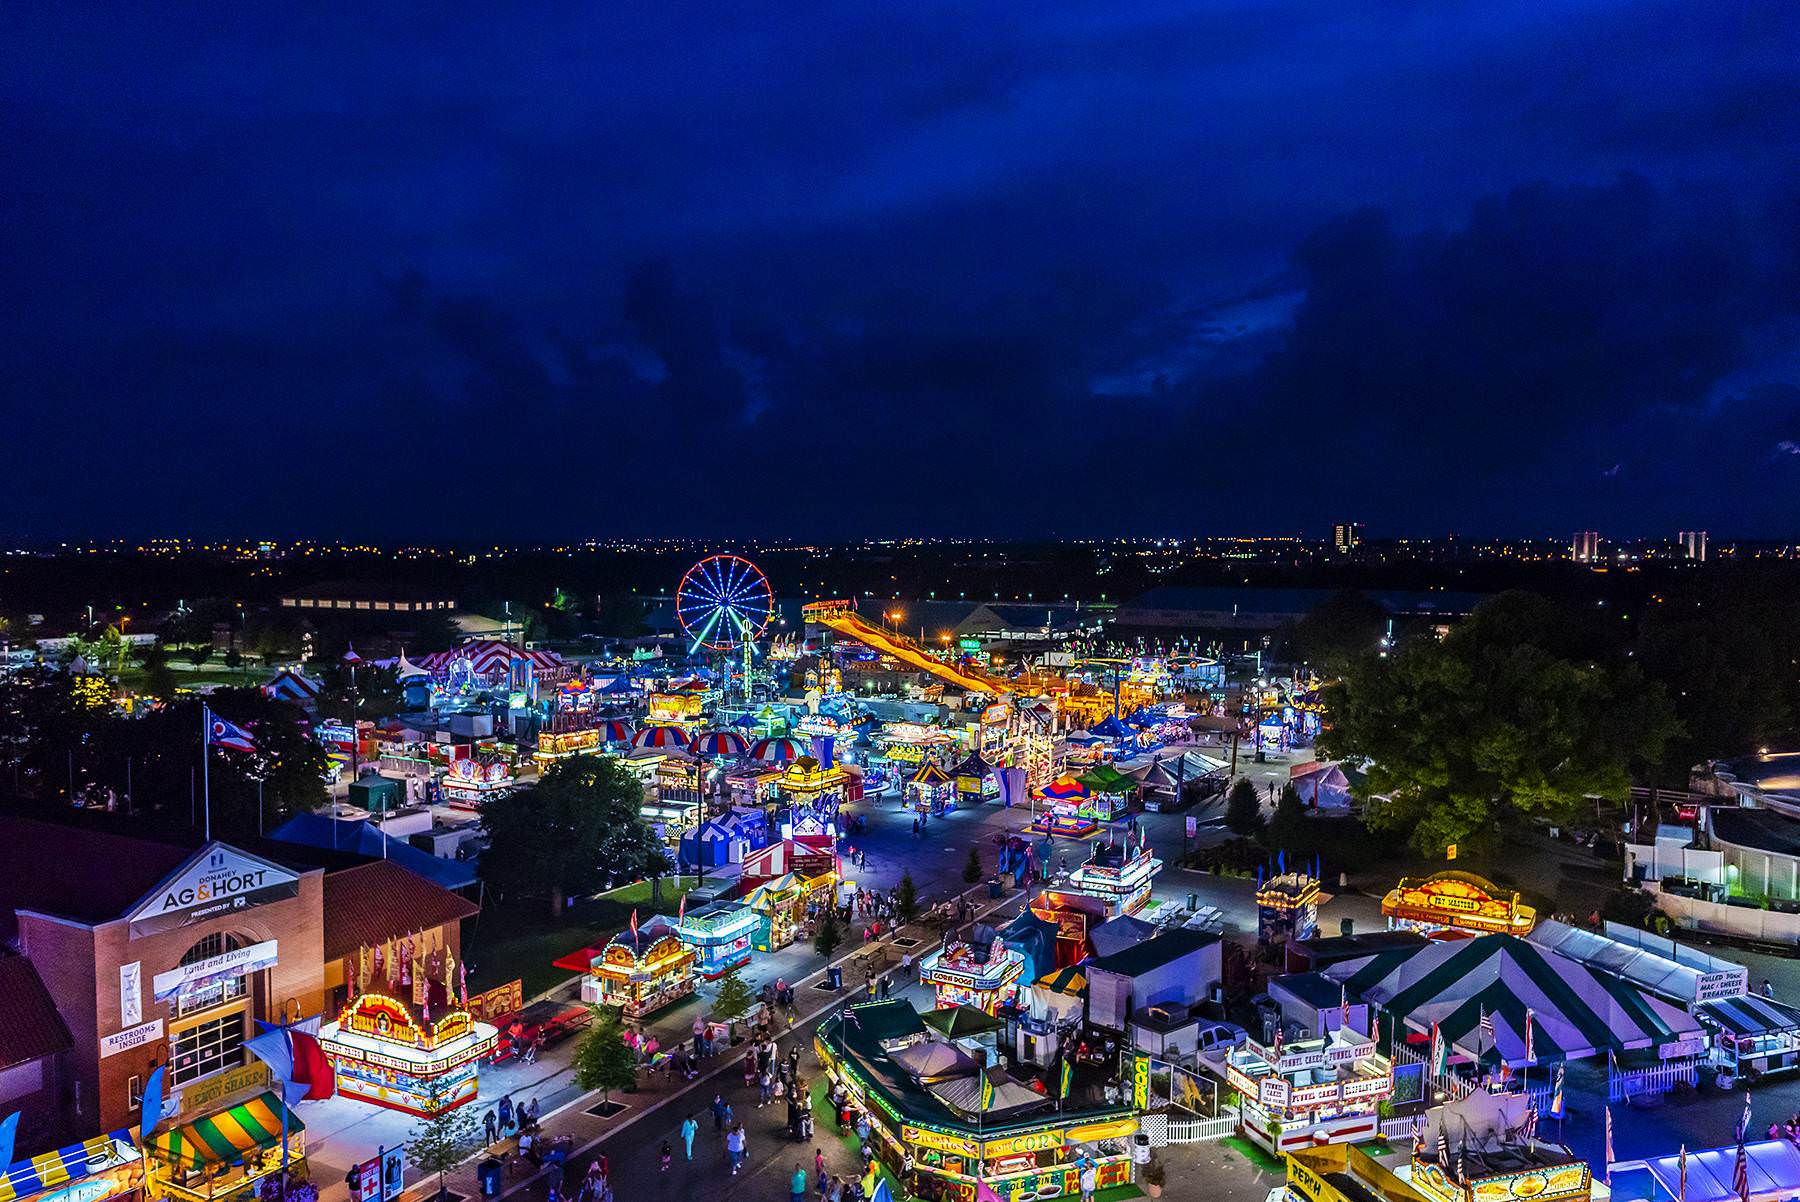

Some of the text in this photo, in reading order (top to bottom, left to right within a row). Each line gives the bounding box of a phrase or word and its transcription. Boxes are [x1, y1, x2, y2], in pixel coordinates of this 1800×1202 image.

[199, 870, 237, 884] DONAHEY
[191, 903, 231, 918] PRESENTED BY
[183, 949, 252, 976] Land and Living
[933, 972, 953, 982] CORN
[954, 975, 972, 986] DOGS
[1700, 974, 1724, 983] PULLED
[1720, 980, 1743, 988] CHEESE
[1702, 988, 1741, 999] BREAKFAST
[109, 1023, 156, 1046] RESTROOMS
[352, 1014, 415, 1044] CURLY FRIES
[119, 1035, 147, 1050] INSIDE
[450, 1042, 488, 1066] CURLY FRIES
[1281, 1054, 1323, 1068] FUNNEL CAKES
[1329, 1046, 1374, 1062] FUNNEL CAKES
[413, 1062, 446, 1072] CORN DOGS
[1264, 1082, 1284, 1092] FUNNEL
[1266, 1090, 1282, 1098] CAKES
[1345, 1080, 1388, 1096] ELEPHANT EARS
[1292, 1089, 1338, 1104] FUNNEL CAKES
[1012, 1132, 1063, 1153] CORN
[1100, 1162, 1126, 1176] ROAST
[1005, 1180, 1026, 1192] COLD
[1292, 1164, 1321, 1196] PERCH
